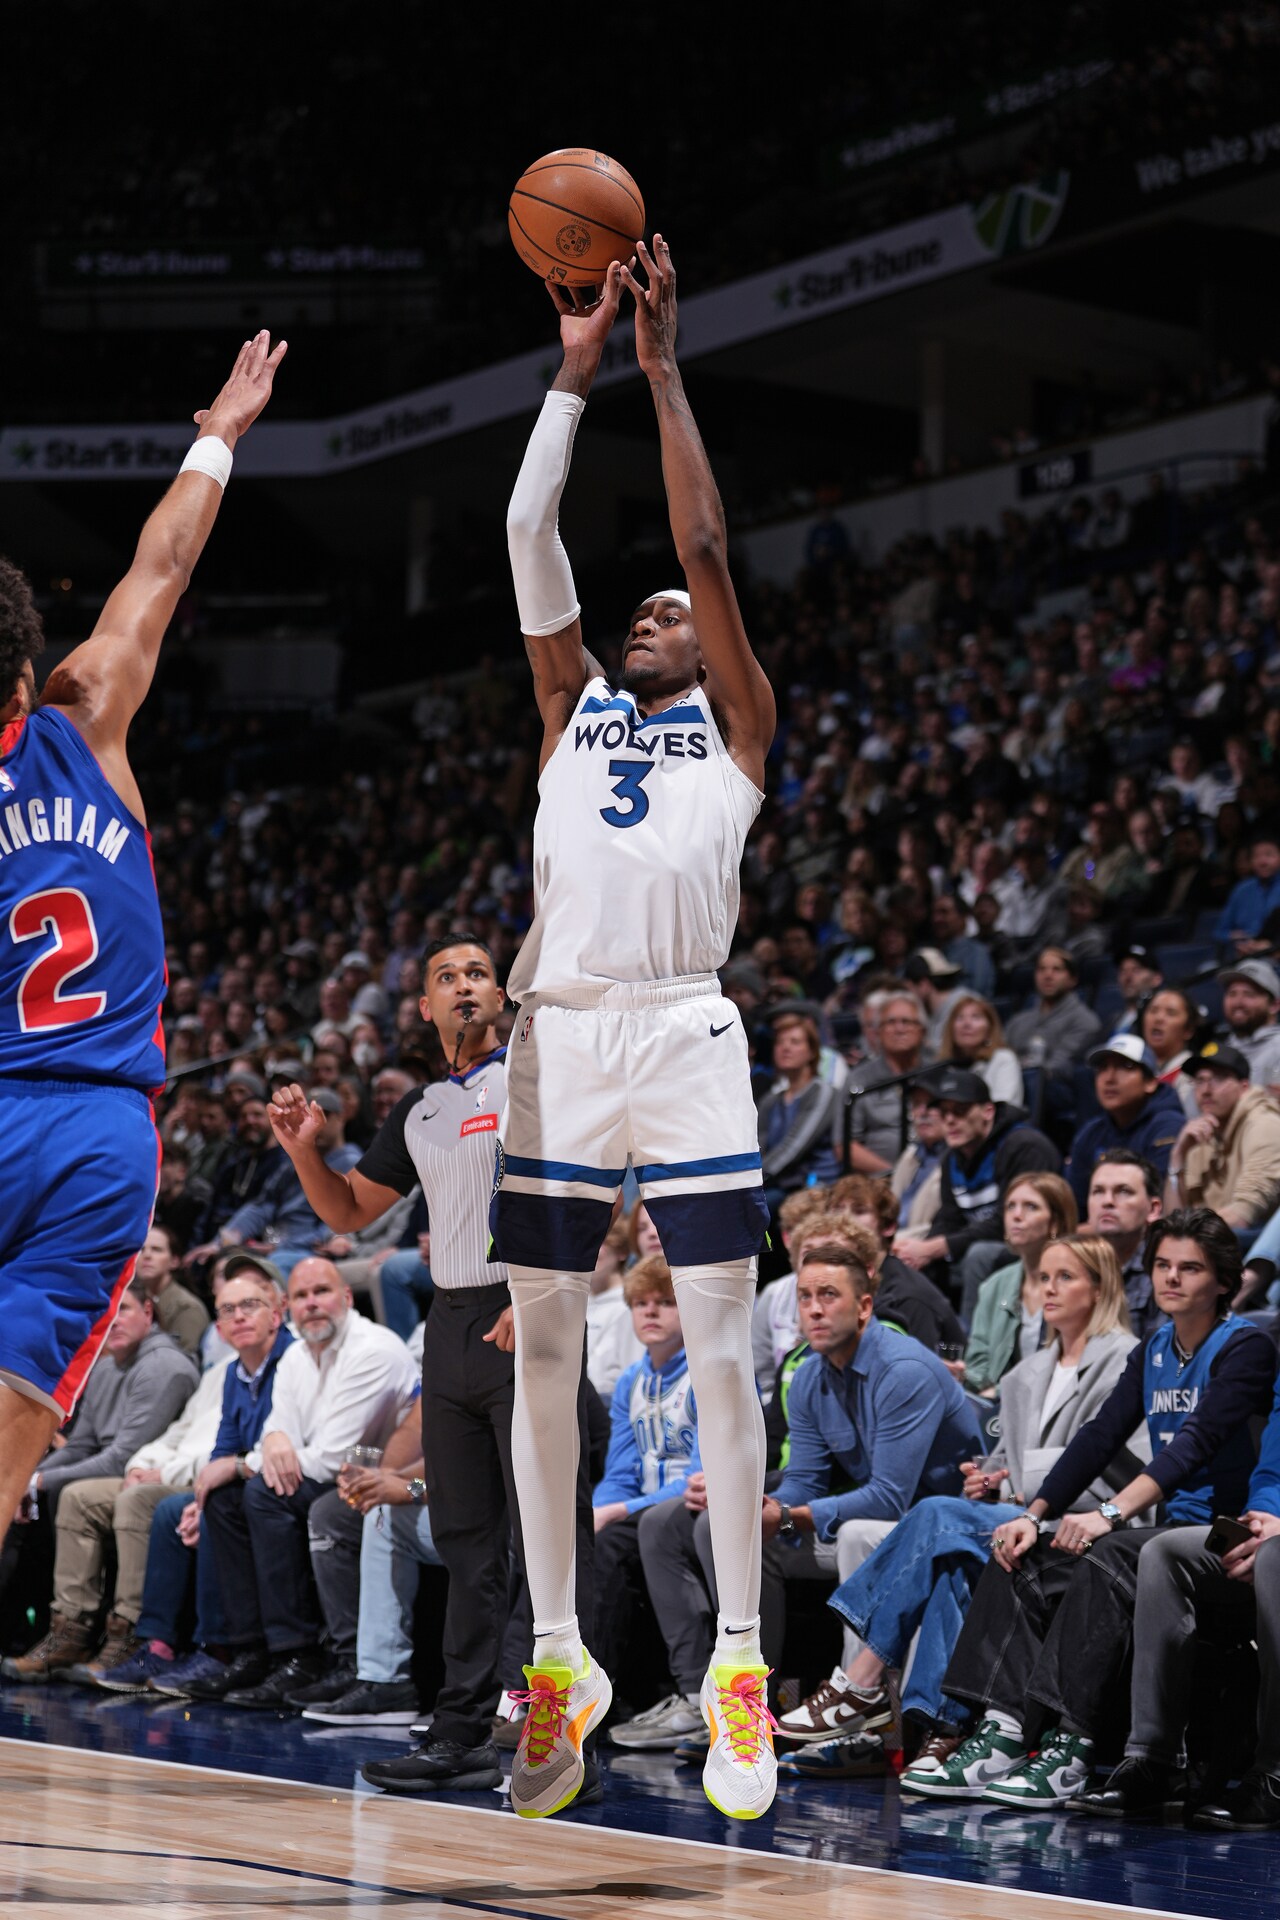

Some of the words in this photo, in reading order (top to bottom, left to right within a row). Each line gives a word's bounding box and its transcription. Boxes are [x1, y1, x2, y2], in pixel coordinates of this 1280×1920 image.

[574, 720, 708, 760] WOLVES
[599, 759, 656, 829] 3
[0, 797, 130, 864] INGHAM
[9, 887, 107, 1033] 2
[462, 1118, 494, 1134] Emirates
